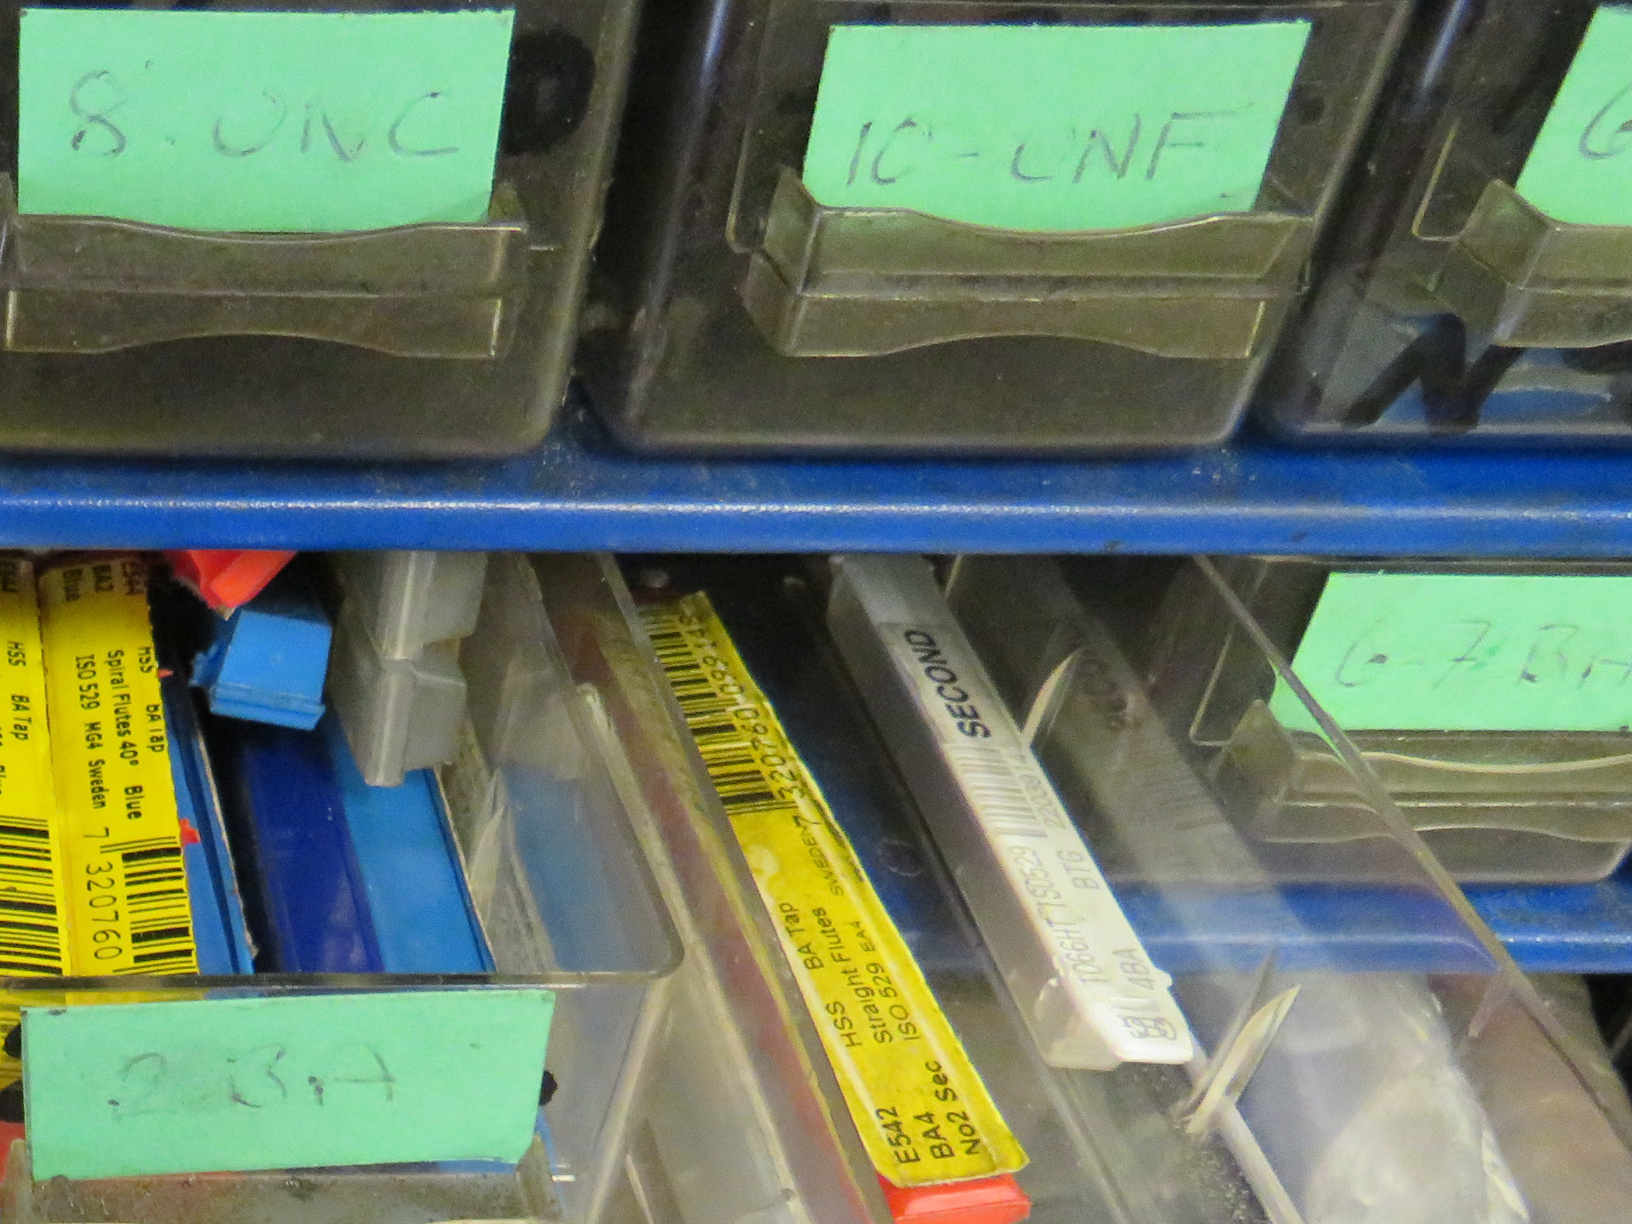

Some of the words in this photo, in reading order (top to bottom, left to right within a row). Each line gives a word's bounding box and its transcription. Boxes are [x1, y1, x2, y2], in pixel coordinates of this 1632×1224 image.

[62, 569, 84, 601] Blue
[92, 564, 114, 592] BA2
[7, 641, 27, 667] HSS
[75, 653, 97, 681] ISO
[104, 649, 130, 689] Spiral
[78, 682, 101, 710] 529
[904, 629, 991, 738] SECOND
[11, 694, 30, 712] BA
[112, 692, 133, 738] Flutes
[9, 717, 32, 740] Tap
[84, 720, 104, 750] MG4
[87, 758, 110, 809] Sweden
[123, 784, 145, 820] Blue
[800, 826, 844, 896] SWEDEN
[85, 861, 123, 960] 320760
[778, 902, 805, 937] Tap
[812, 907, 852, 963] Flutes
[797, 942, 824, 970] BA
[866, 962, 899, 998] 529
[840, 968, 893, 1043] Straight
[889, 1004, 921, 1041] ISO
[825, 1001, 862, 1047] HSS
[925, 1060, 958, 1102] Sec
[875, 1106, 921, 1164] E542
